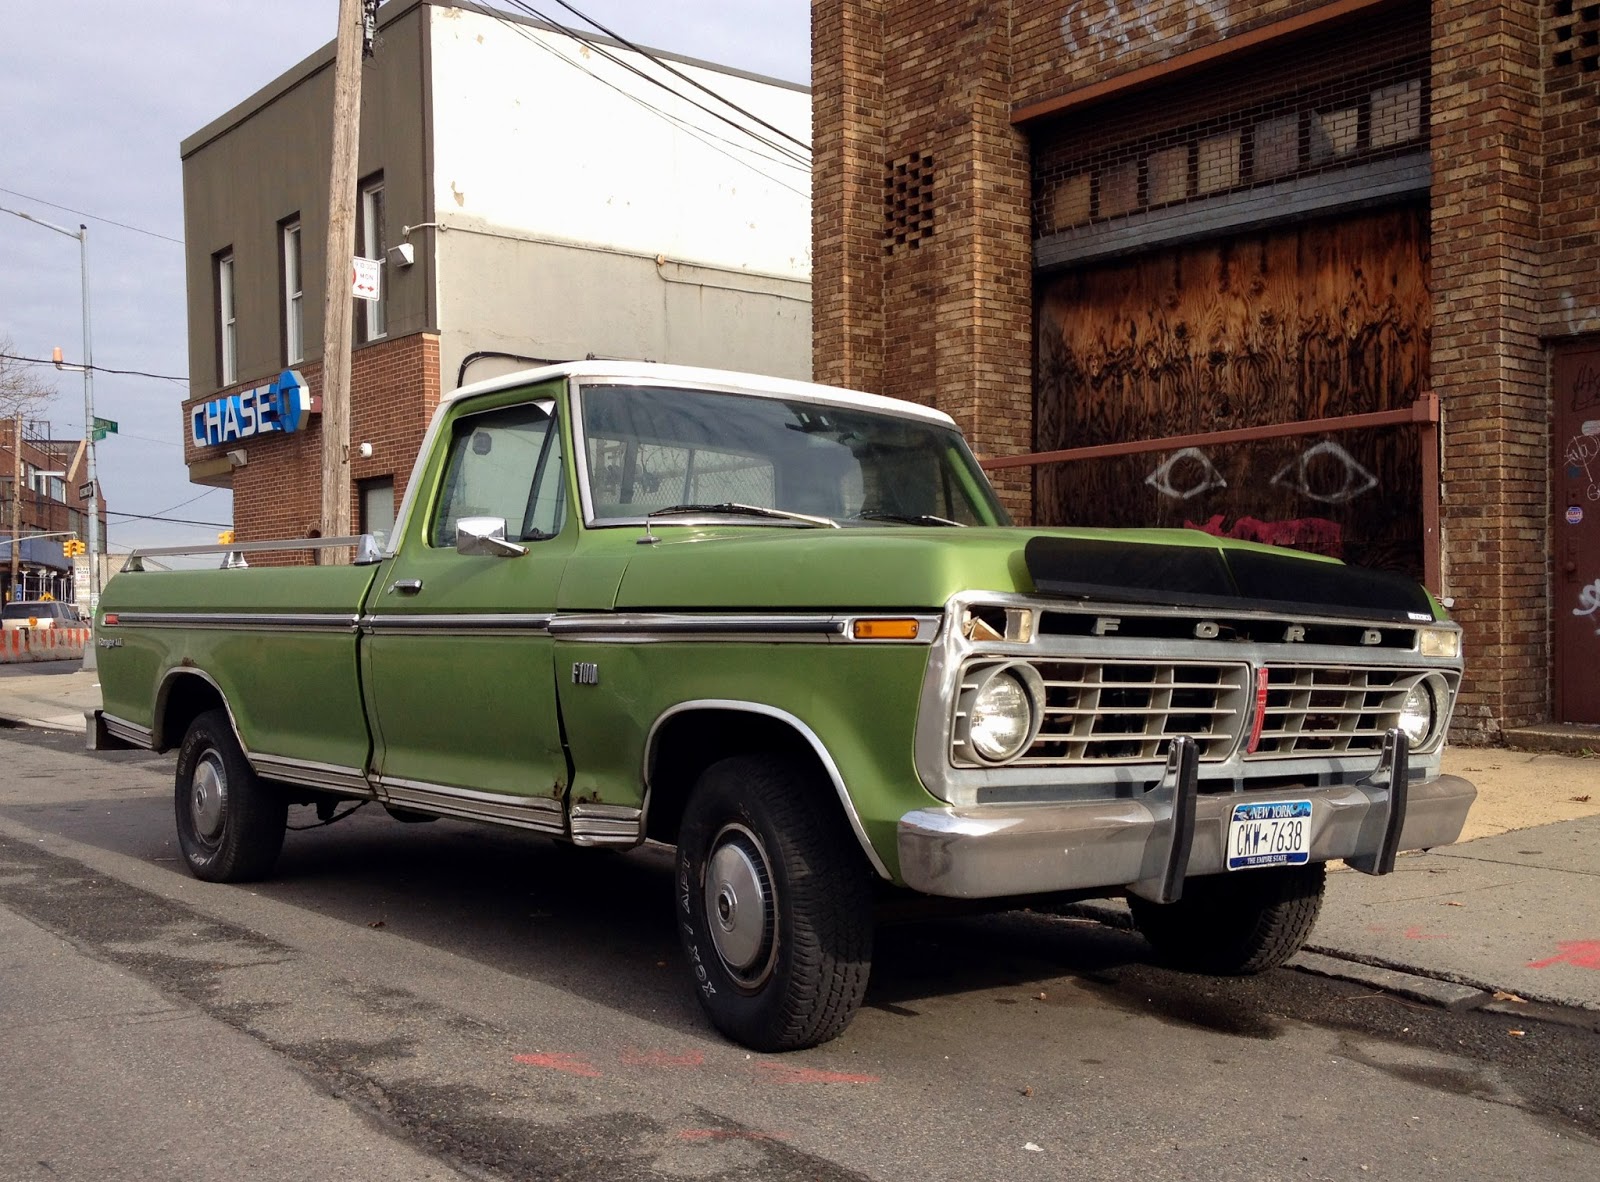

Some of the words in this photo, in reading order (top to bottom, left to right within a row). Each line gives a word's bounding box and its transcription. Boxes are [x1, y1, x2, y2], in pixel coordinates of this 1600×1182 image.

[191, 384, 273, 448] CHASE
[1251, 806, 1270, 819] NEW
[1271, 804, 1292, 818] YORK
[1247, 857, 1256, 865] THE
[1256, 855, 1273, 864] EMPIRE
[1273, 854, 1288, 862] STATE
